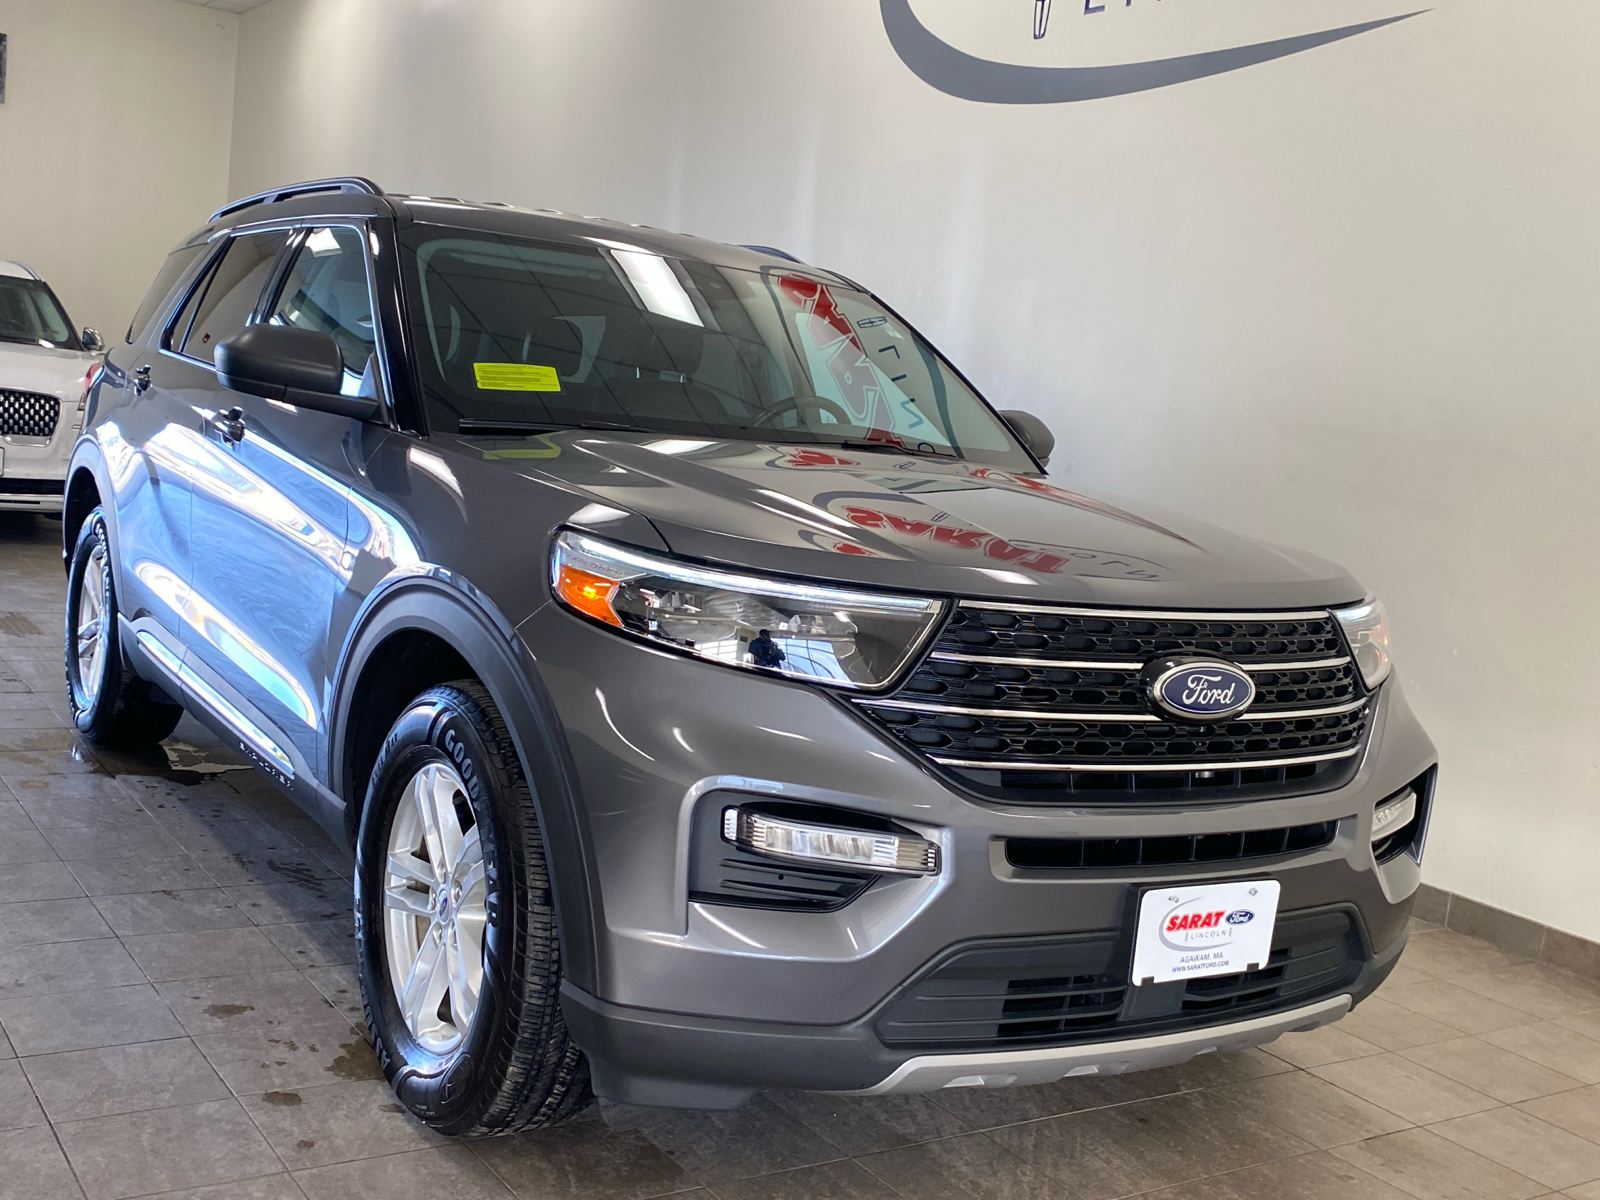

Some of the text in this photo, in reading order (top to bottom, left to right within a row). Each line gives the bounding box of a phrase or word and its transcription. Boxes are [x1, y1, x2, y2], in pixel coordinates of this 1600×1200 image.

[1181, 673, 1237, 705] Ford
[1166, 910, 1251, 932] SARAT Ford
[1190, 930, 1227, 939] LINCOLN
[1180, 954, 1211, 963] AGAWAM,
[1172, 961, 1229, 973] WWW.SARATFORD.COM
